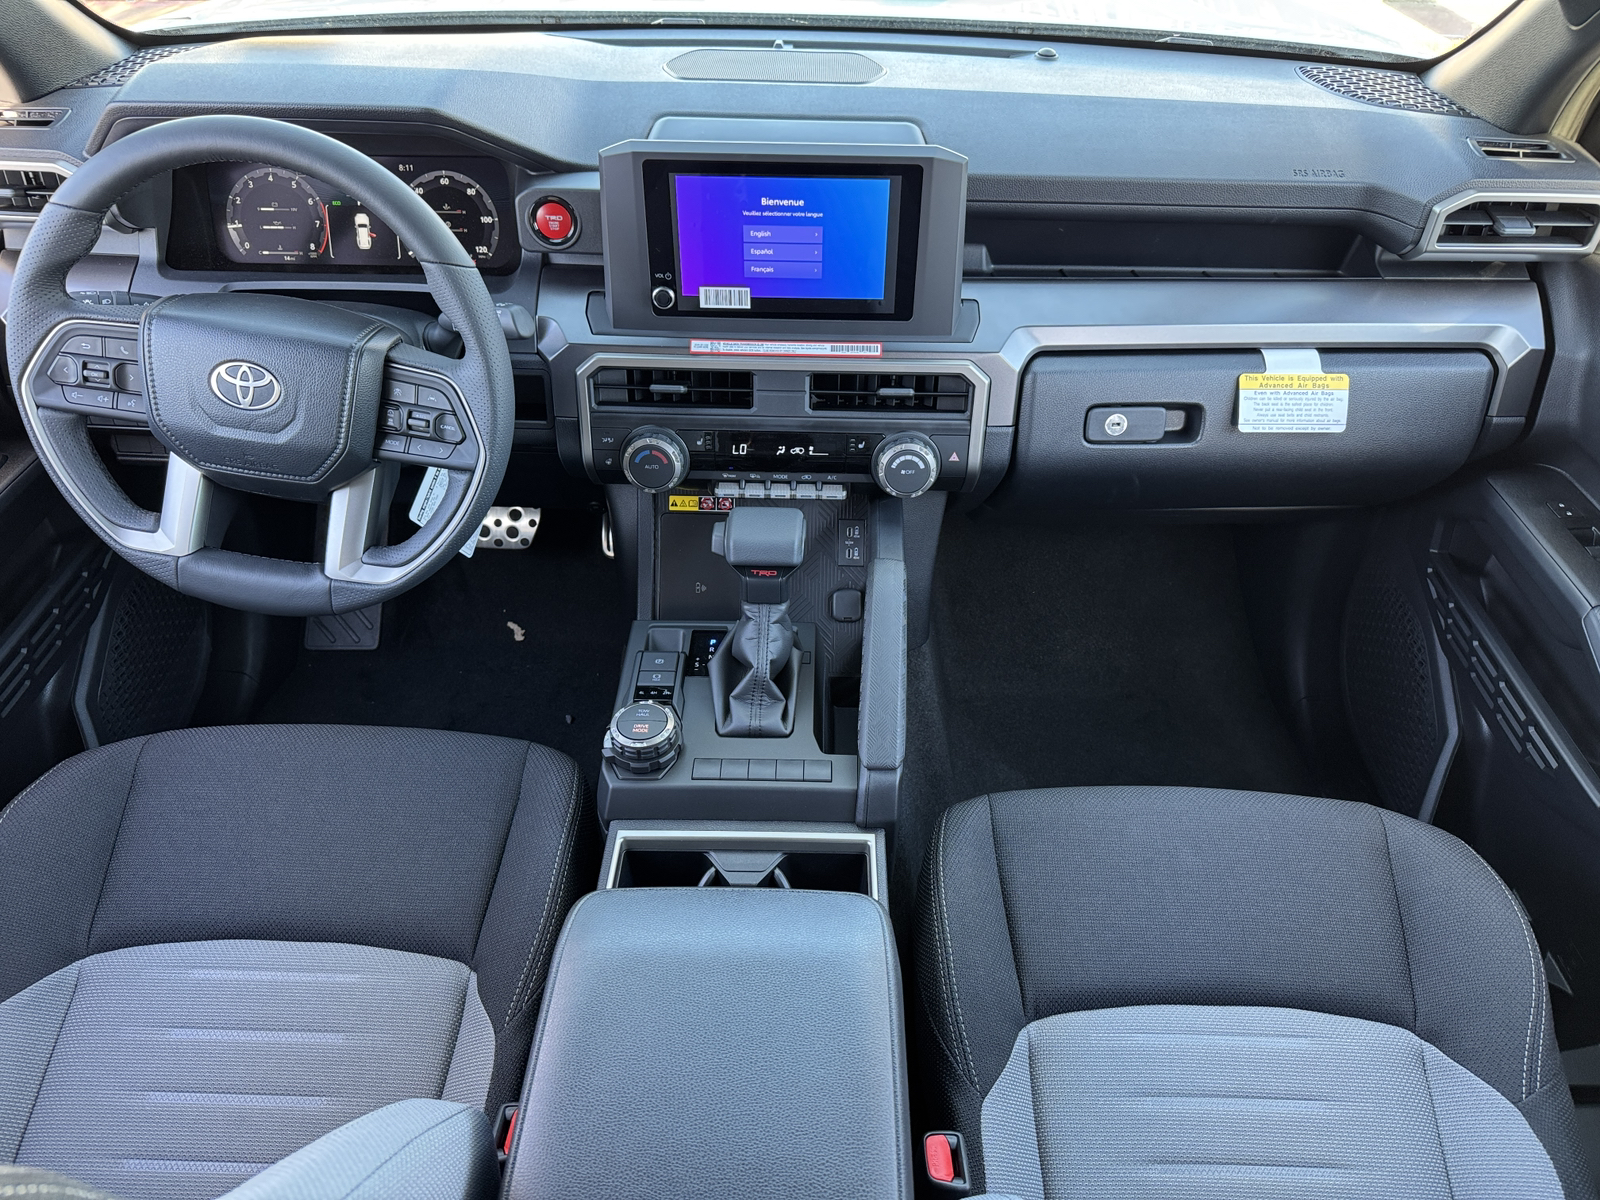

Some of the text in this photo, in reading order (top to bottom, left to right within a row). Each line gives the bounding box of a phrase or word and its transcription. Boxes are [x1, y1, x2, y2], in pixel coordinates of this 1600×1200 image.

[1292, 169, 1345, 178] SRS AIRBAG
[267, 174, 273, 182] 4
[291, 181, 297, 189] 5
[235, 196, 241, 204] 2
[761, 197, 805, 206] Bienvenue
[315, 220, 320, 228] 7
[750, 230, 772, 238] English
[310, 242, 315, 250] 8
[440, 424, 456, 432] CANCEL
[732, 444, 747, 455] LO
